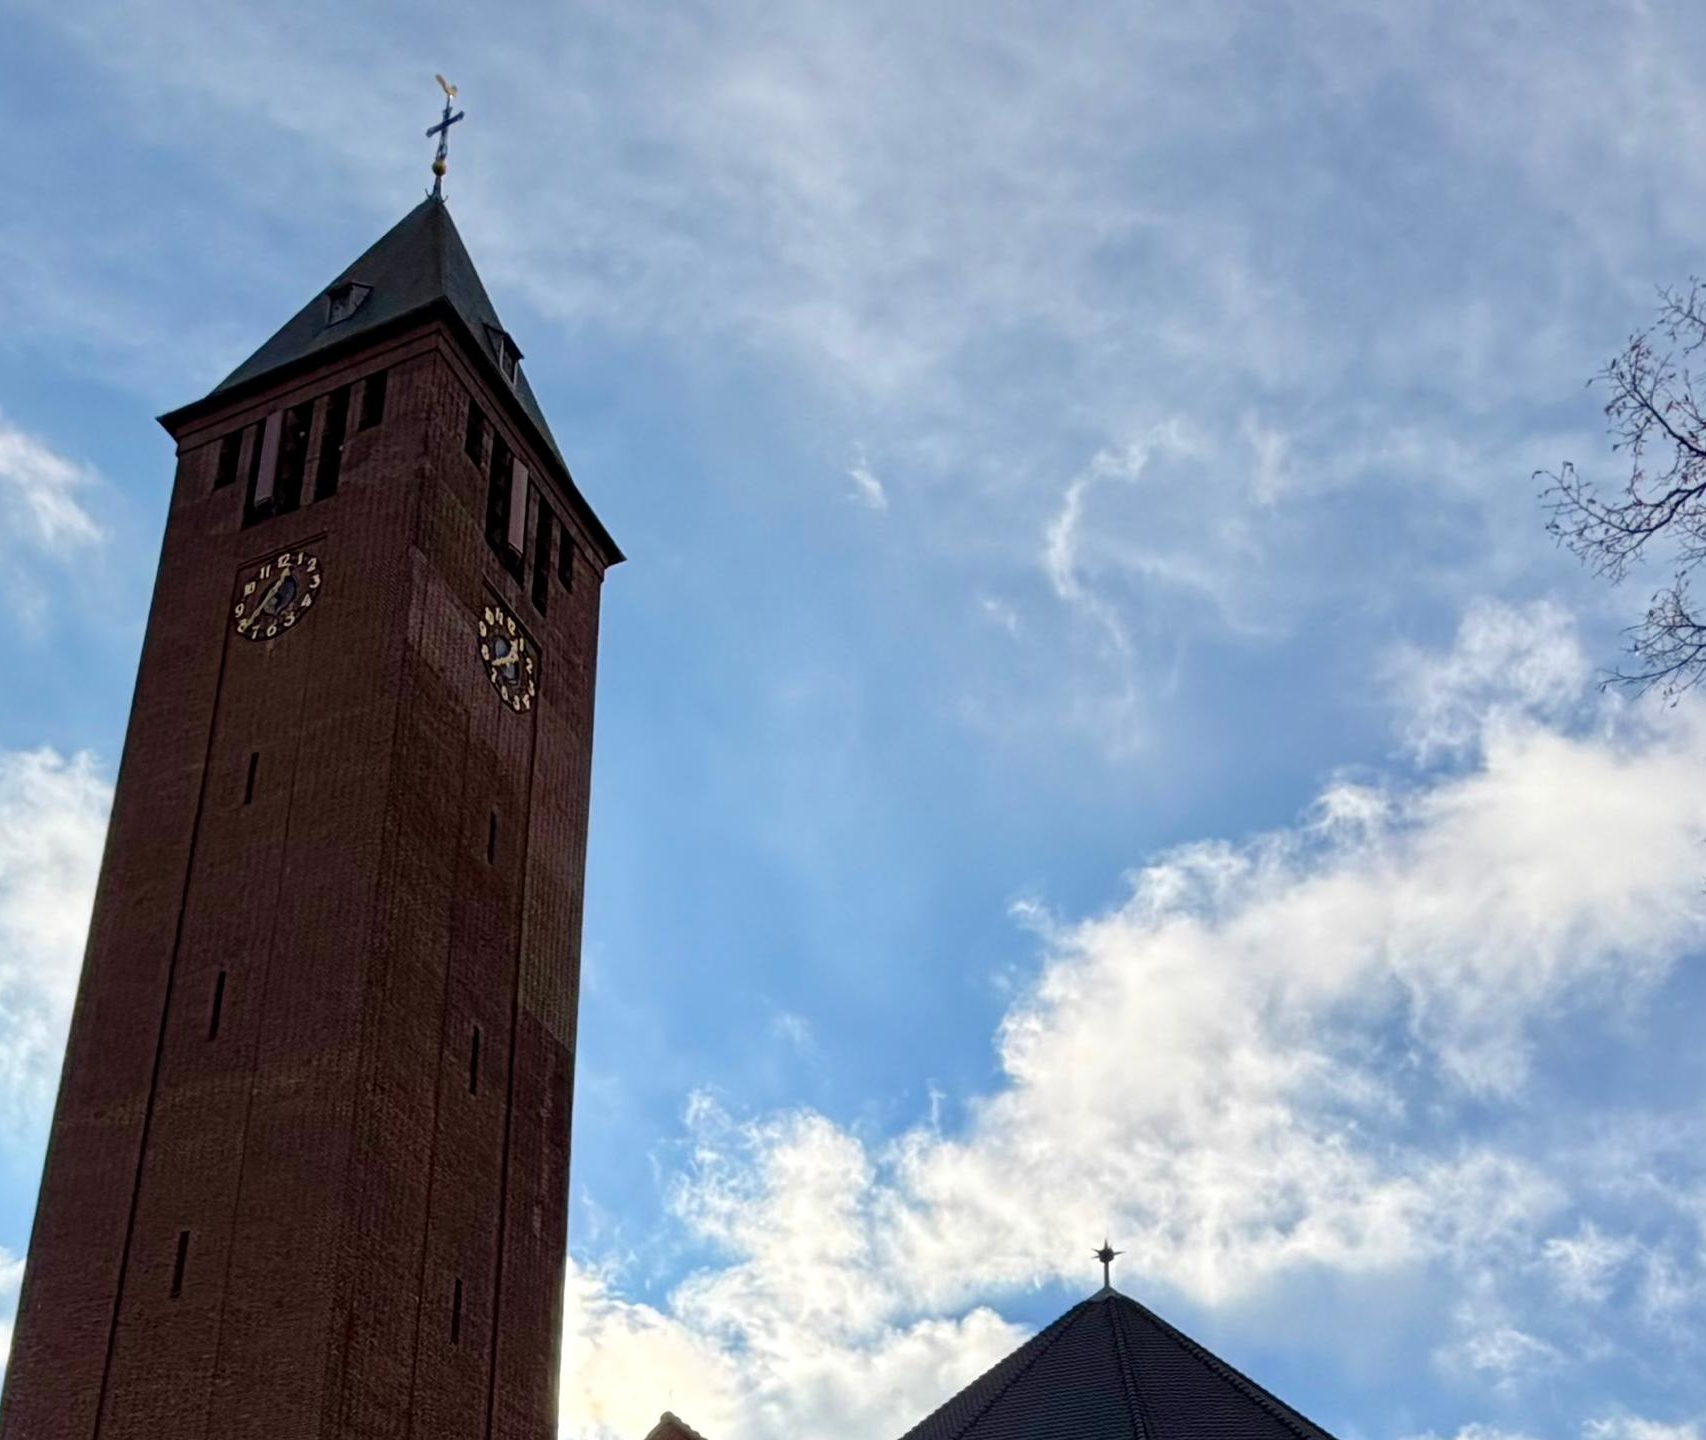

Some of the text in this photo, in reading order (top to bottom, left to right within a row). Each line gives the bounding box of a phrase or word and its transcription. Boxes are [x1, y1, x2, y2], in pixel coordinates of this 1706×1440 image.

[278, 553, 292, 568] 12
[297, 551, 304, 565] 1
[307, 557, 317, 572] 2
[259, 564, 271, 579] 11
[309, 573, 321, 589] 3
[300, 593, 312, 607] 4
[235, 602, 245, 618] 9
[252, 624, 261, 639] 7
[266, 619, 277, 637] 6
